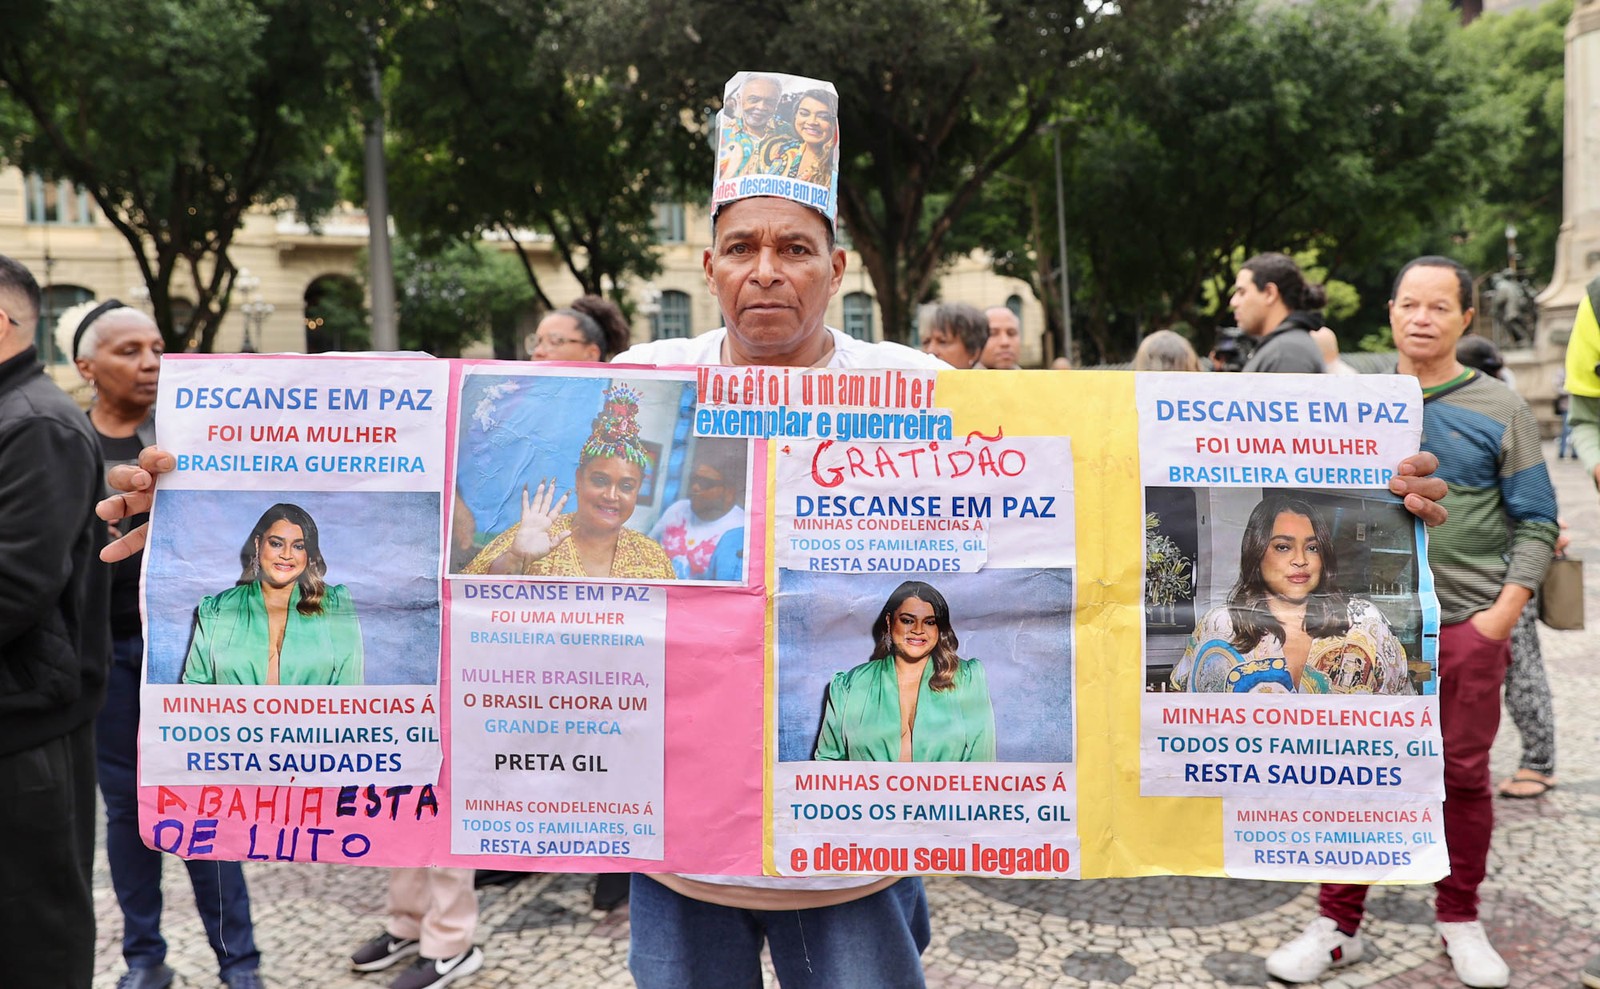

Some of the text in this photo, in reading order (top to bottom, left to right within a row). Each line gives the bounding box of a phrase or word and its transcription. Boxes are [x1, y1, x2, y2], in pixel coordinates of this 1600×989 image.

[740, 178, 791, 197] descanse
[793, 182, 809, 201] em
[811, 187, 829, 206] paz
[175, 387, 433, 410] DESCANSE EM PAZ
[1156, 400, 1408, 424] DESCANSE EM PAZ
[696, 406, 952, 441] exemplar e guerreira
[208, 425, 397, 443] FOI UMA MULHER
[1196, 437, 1378, 455] FOI UMA MULHER
[176, 455, 425, 473] BRASILEIRA GUERREIRA
[1169, 466, 1393, 484] BRASILEIRA GUERREIR
[796, 496, 1055, 518] DESCANSE EM PAZ
[794, 519, 852, 530] MINHAS
[857, 520, 969, 531] CONDELENCIAS
[790, 538, 986, 553] TODOS OS FAMILIARES, GIL
[809, 558, 960, 572] RESTA SAUDADES
[464, 584, 650, 601] DESCANSE EM PAZ
[491, 611, 624, 624] FOI UMA MULHER
[471, 632, 644, 646] BRASILEIRA GUERREIRA
[462, 669, 649, 688] MULHER BRASILEIRA,
[163, 694, 435, 714] MINHAS CONDELENCIAS Á
[464, 694, 647, 711] O BRASIL CHORA UM
[1162, 706, 1432, 727] MINHAS CONDELENCIAS Á
[159, 726, 439, 745] TODOS OS FAMILIARES, GIL
[485, 719, 621, 735] GRANDE PERCA
[1158, 736, 1438, 759] TODOS OS FAMILIARES, GIL
[187, 752, 402, 772] RESTA SAUDADES
[495, 754, 607, 772] PRETA GIL
[795, 772, 1066, 792] MINHAS CONDELENCIAS Á
[1185, 763, 1402, 786] RESTA SAUDADES
[157, 785, 187, 815] A
[336, 784, 439, 820] ESTA
[465, 800, 653, 815] MINHAS CONDELENCIAS Á
[791, 803, 1070, 823] TODOS OS FAMILIARES, GIL
[1237, 808, 1432, 823] MINHAS CONDELENCIAS Á
[462, 819, 656, 836] TODOS OS FAMILIARES, GIL
[153, 819, 371, 861] DE LUTO
[1234, 830, 1436, 845] TODOS OS FAMILIARES, GIL
[480, 839, 630, 855] RESTA SAUDADES
[790, 843, 1069, 875] e deixou seu legado
[1254, 850, 1411, 866] RESTA SAUDADES
